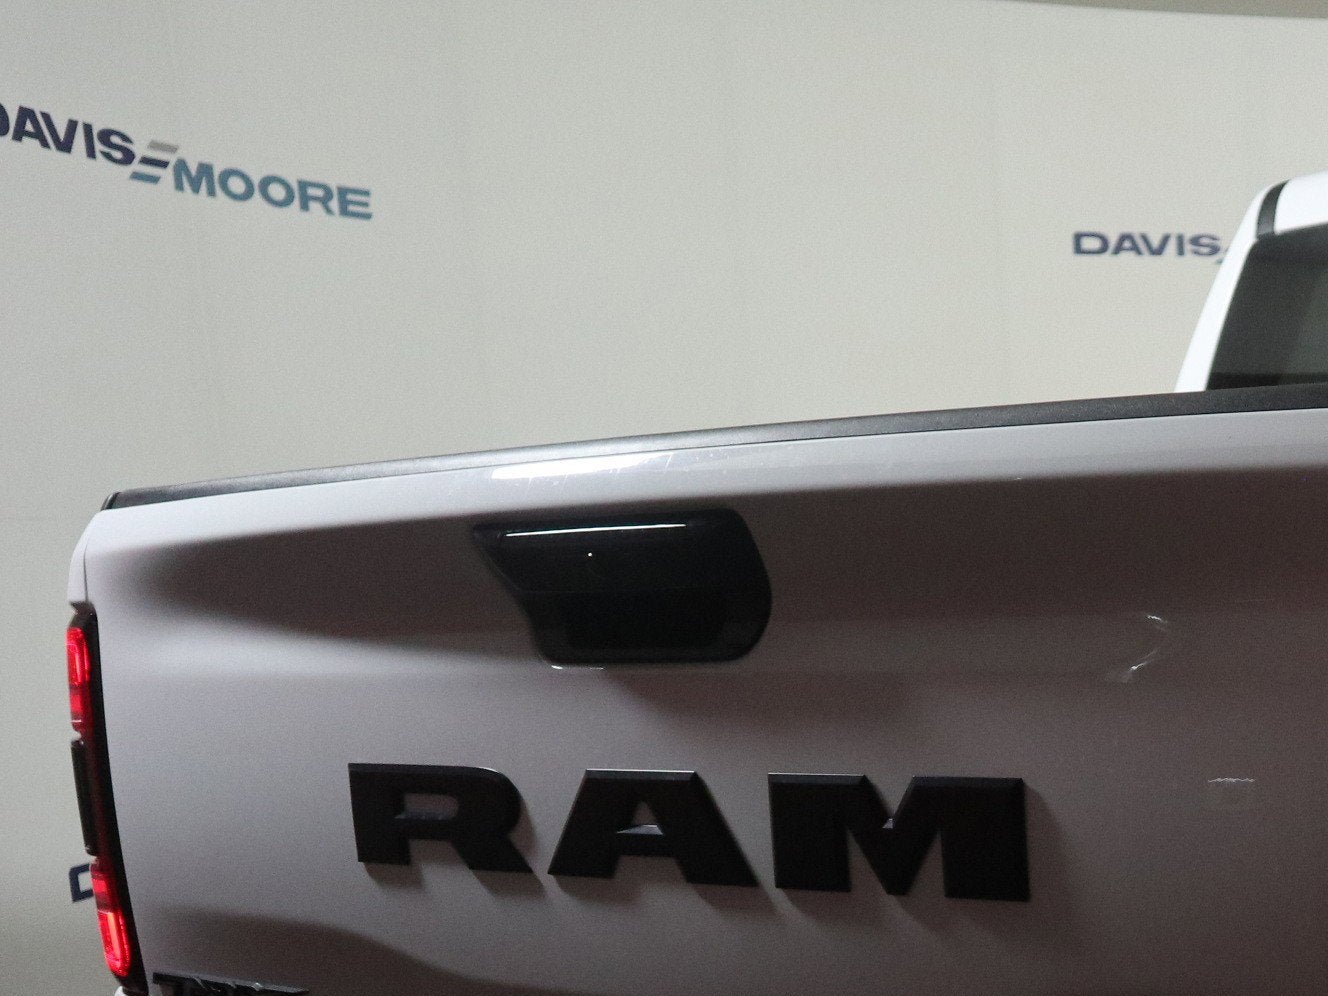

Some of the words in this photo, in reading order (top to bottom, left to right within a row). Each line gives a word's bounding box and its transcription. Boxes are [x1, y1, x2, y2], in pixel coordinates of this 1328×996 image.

[0, 103, 136, 168] AVIS
[172, 157, 374, 221] MOORE
[1072, 231, 1222, 257] DAVIS
[348, 762, 1031, 902] RAM
